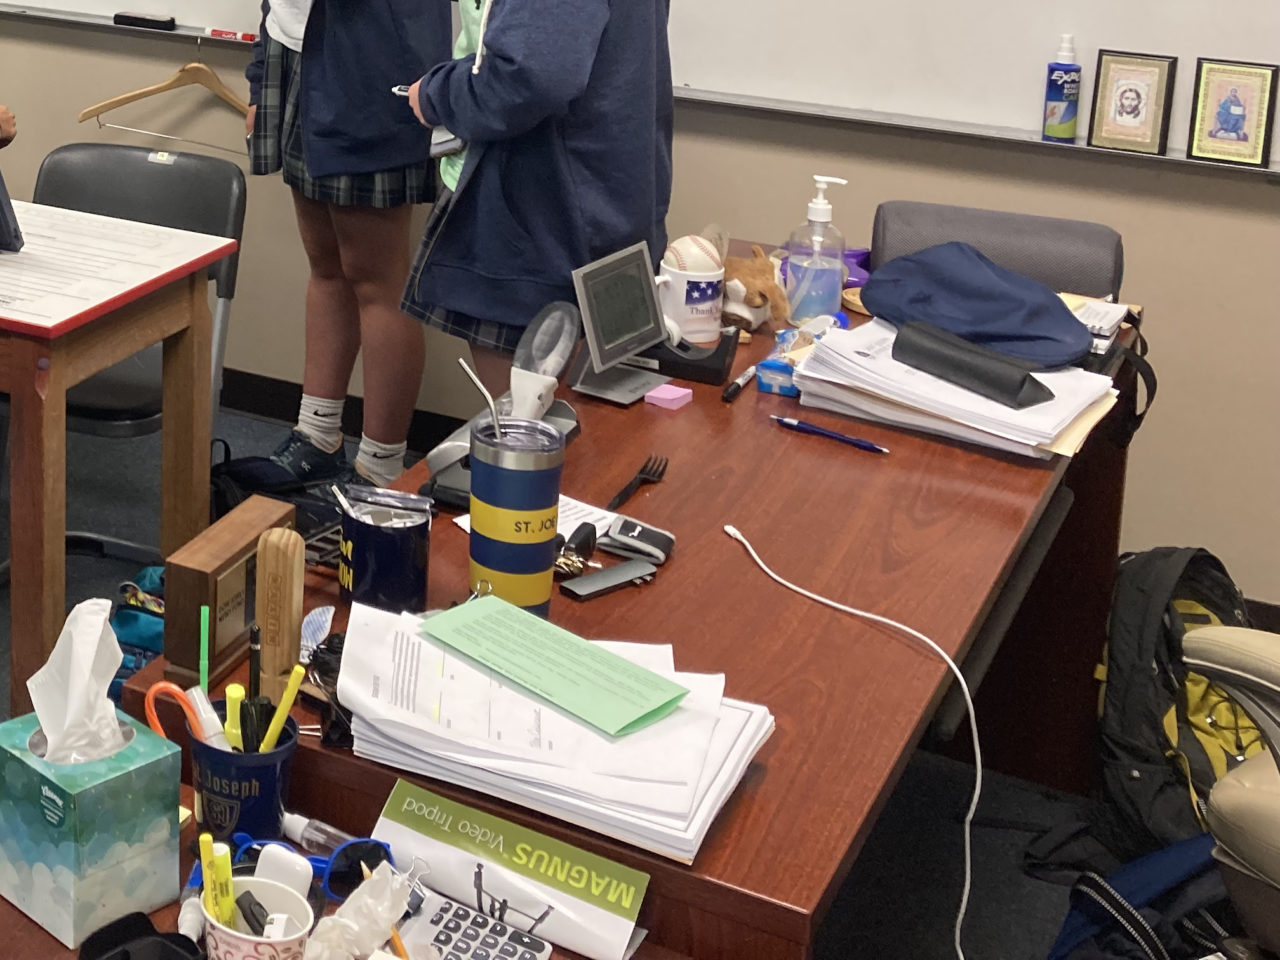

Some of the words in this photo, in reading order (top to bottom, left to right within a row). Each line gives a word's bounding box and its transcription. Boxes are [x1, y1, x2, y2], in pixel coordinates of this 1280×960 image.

[514, 519, 536, 534] ST.
[206, 770, 260, 800] Joseph
[401, 795, 455, 833] Tripod
[458, 818, 504, 854] Video
[512, 843, 637, 910] MAGNUS
